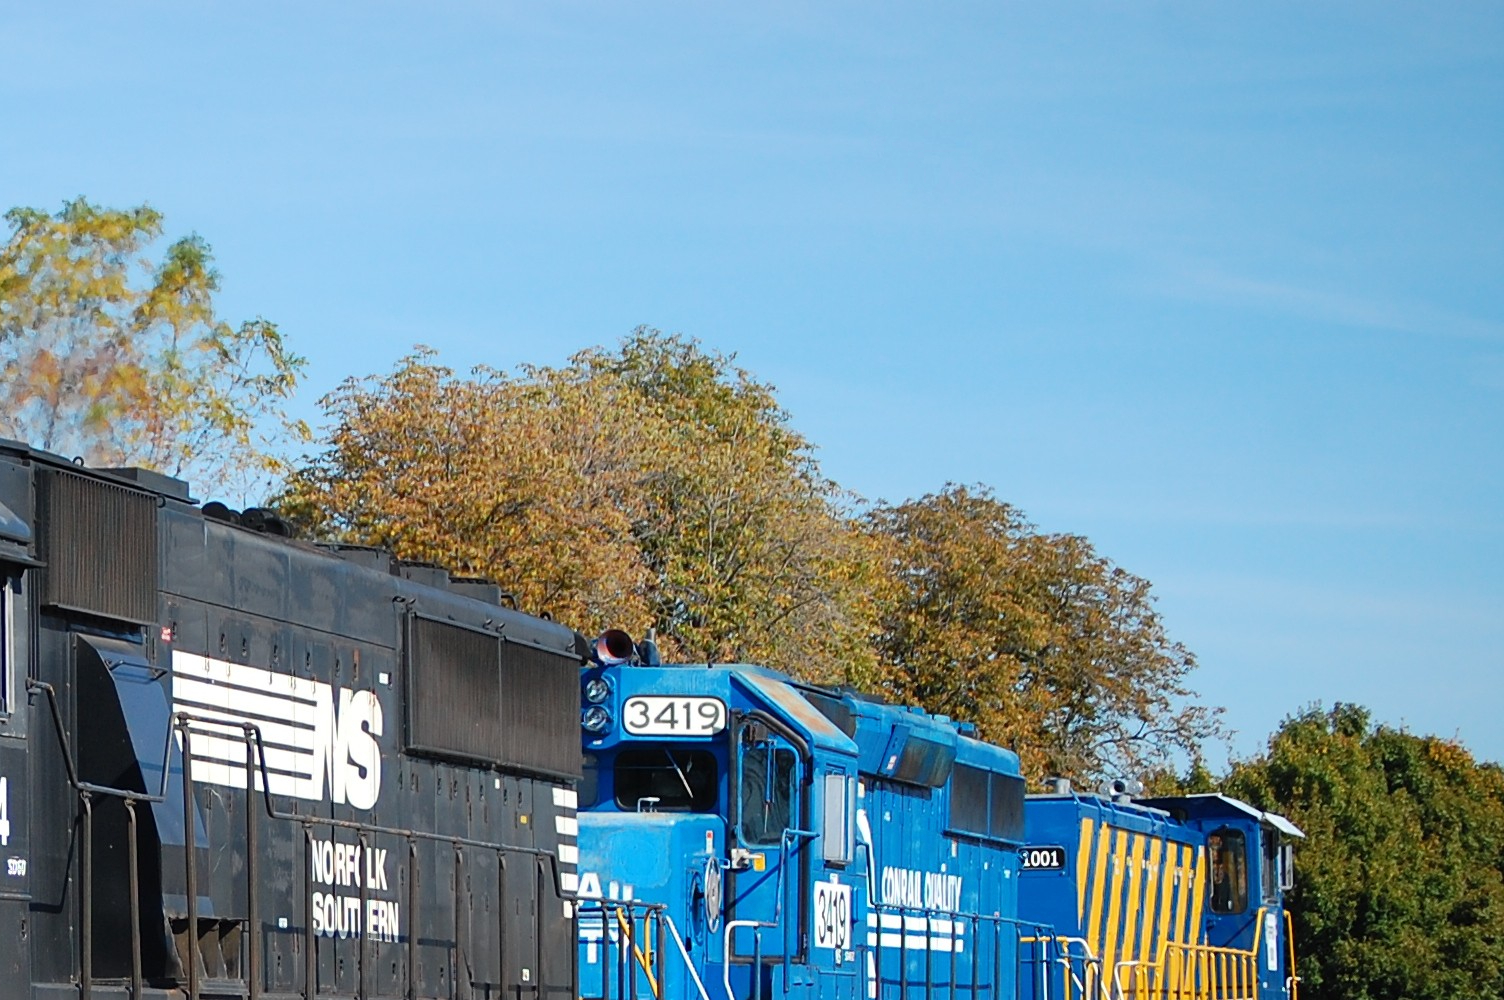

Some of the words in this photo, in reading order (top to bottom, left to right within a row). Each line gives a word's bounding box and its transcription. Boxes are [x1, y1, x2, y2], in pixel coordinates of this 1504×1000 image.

[629, 701, 720, 730] 3419
[312, 682, 383, 811] NS
[881, 866, 922, 912] CONRAIL
[924, 871, 963, 914] QUALITY
[312, 892, 399, 943] SOUTERN
[818, 889, 847, 946] 3419
